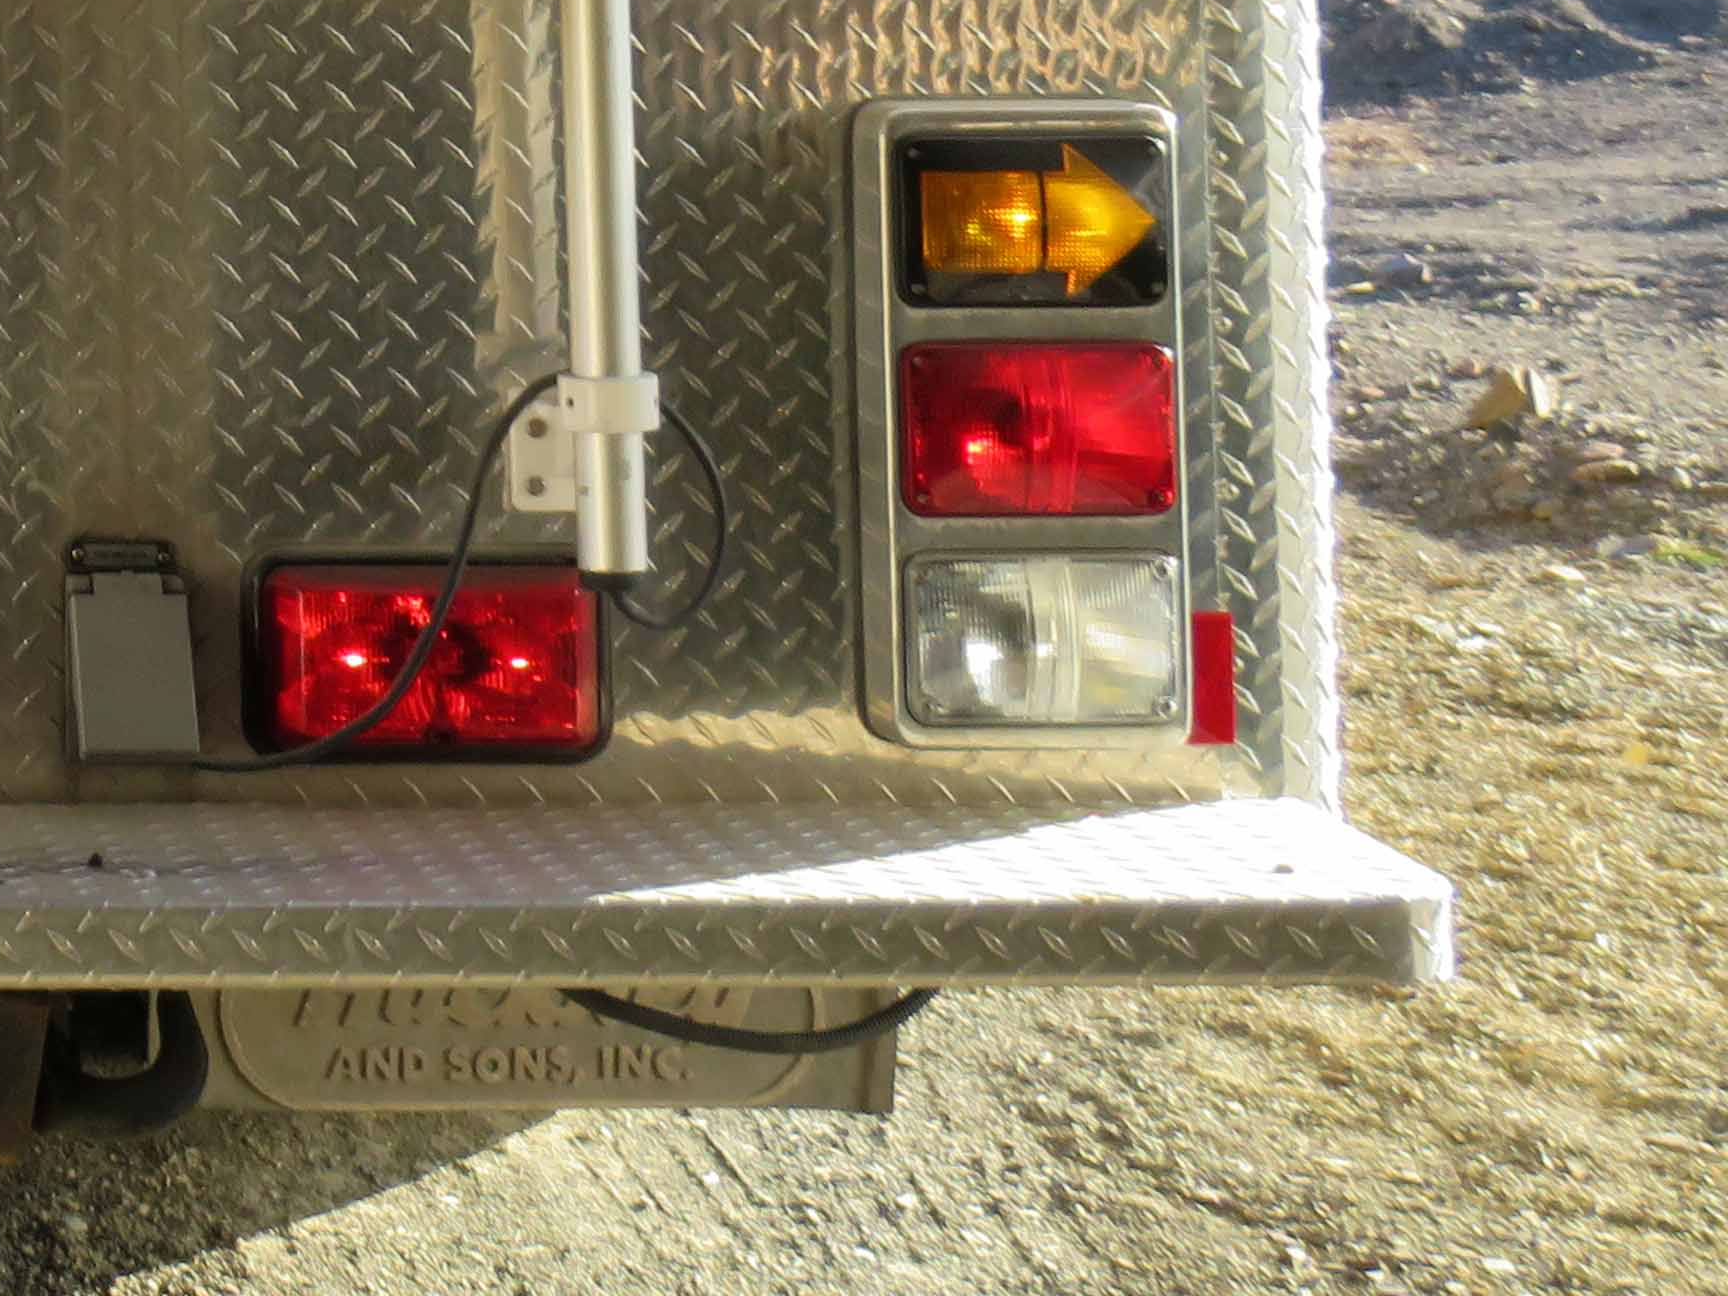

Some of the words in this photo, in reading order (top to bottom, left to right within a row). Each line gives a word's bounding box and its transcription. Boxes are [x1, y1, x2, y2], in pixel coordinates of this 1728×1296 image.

[325, 1045, 425, 1082] AND
[443, 1046, 579, 1086] SONS,
[597, 1045, 693, 1082] INC.
